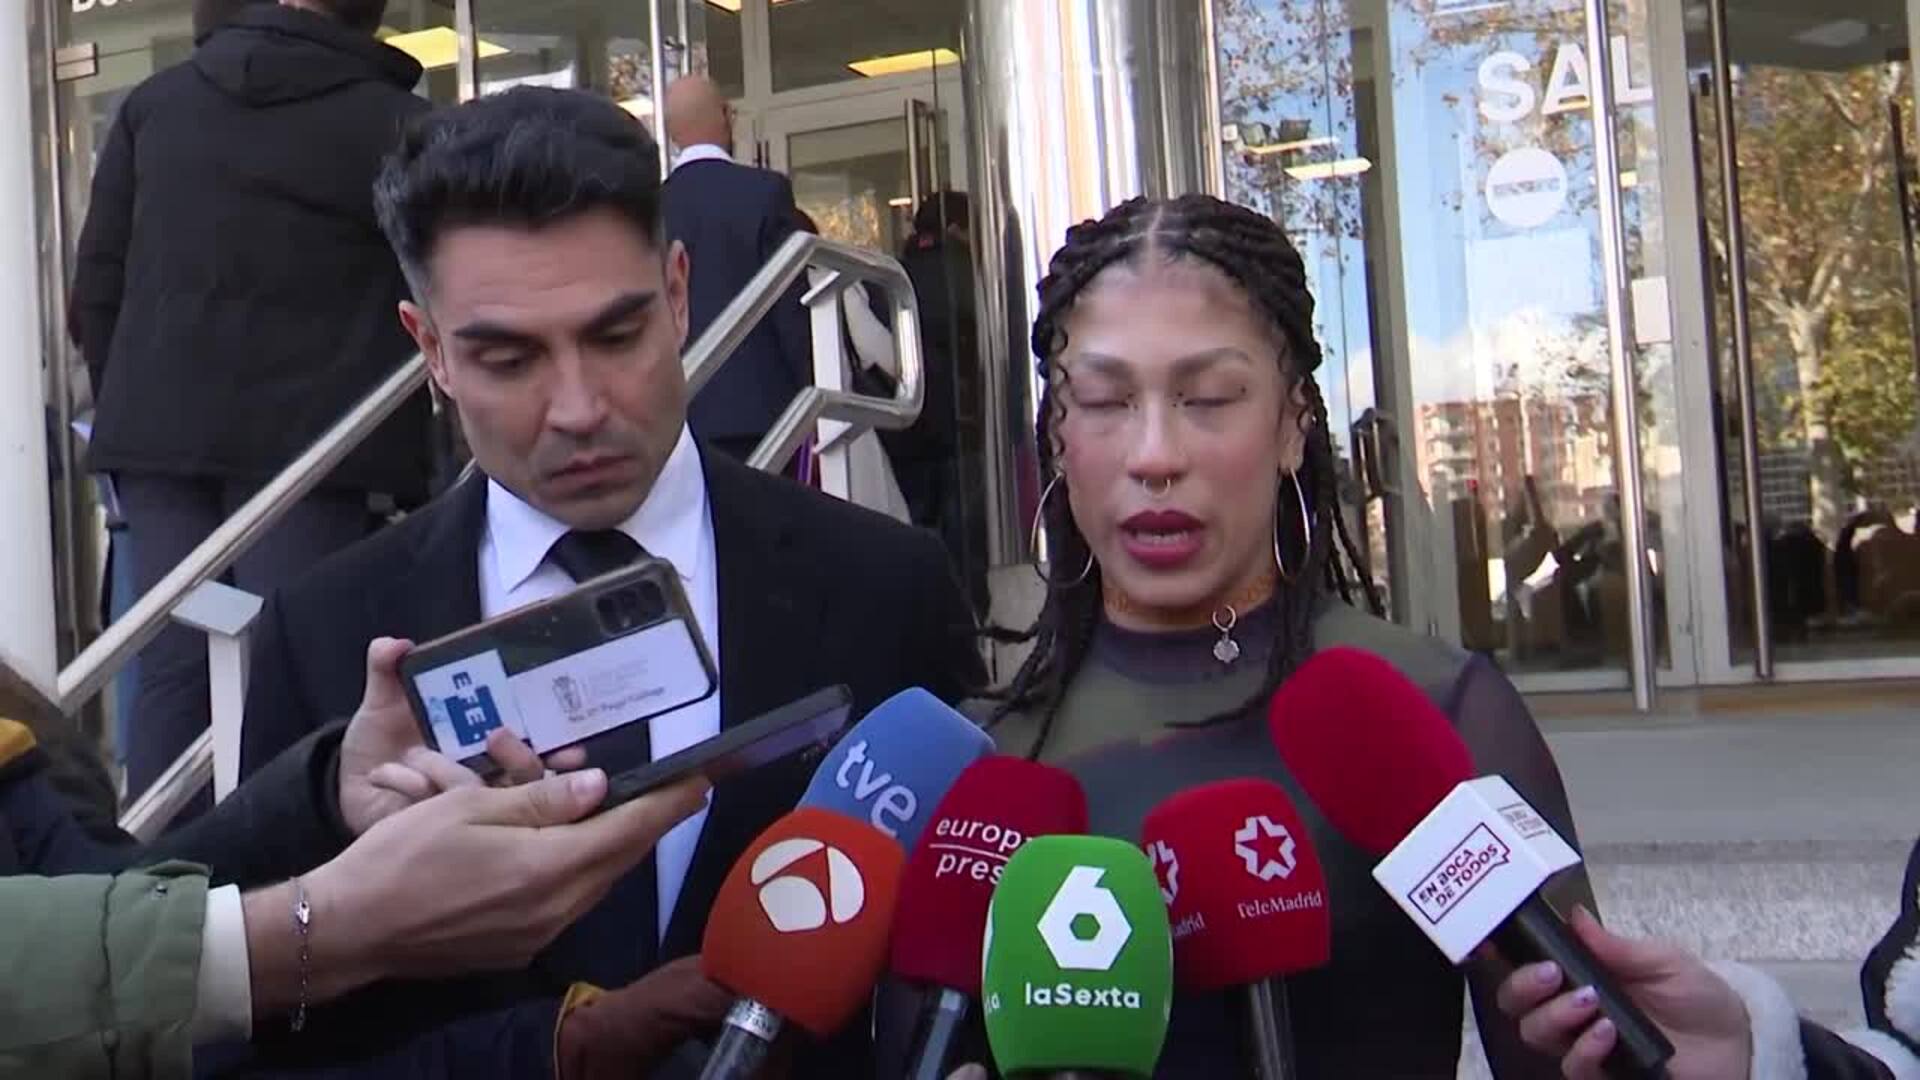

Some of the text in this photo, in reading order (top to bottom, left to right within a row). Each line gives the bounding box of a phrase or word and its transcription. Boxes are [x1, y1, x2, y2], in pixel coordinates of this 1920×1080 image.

[836, 740, 917, 838] tve
[936, 817, 1032, 852] europ
[935, 853, 1004, 885] pres
[1418, 849, 1475, 904] EN BOCA
[1435, 843, 1498, 907] DE TODOS
[1237, 888, 1323, 919] TeleMadrid
[1025, 982, 1140, 1008] laSexta
